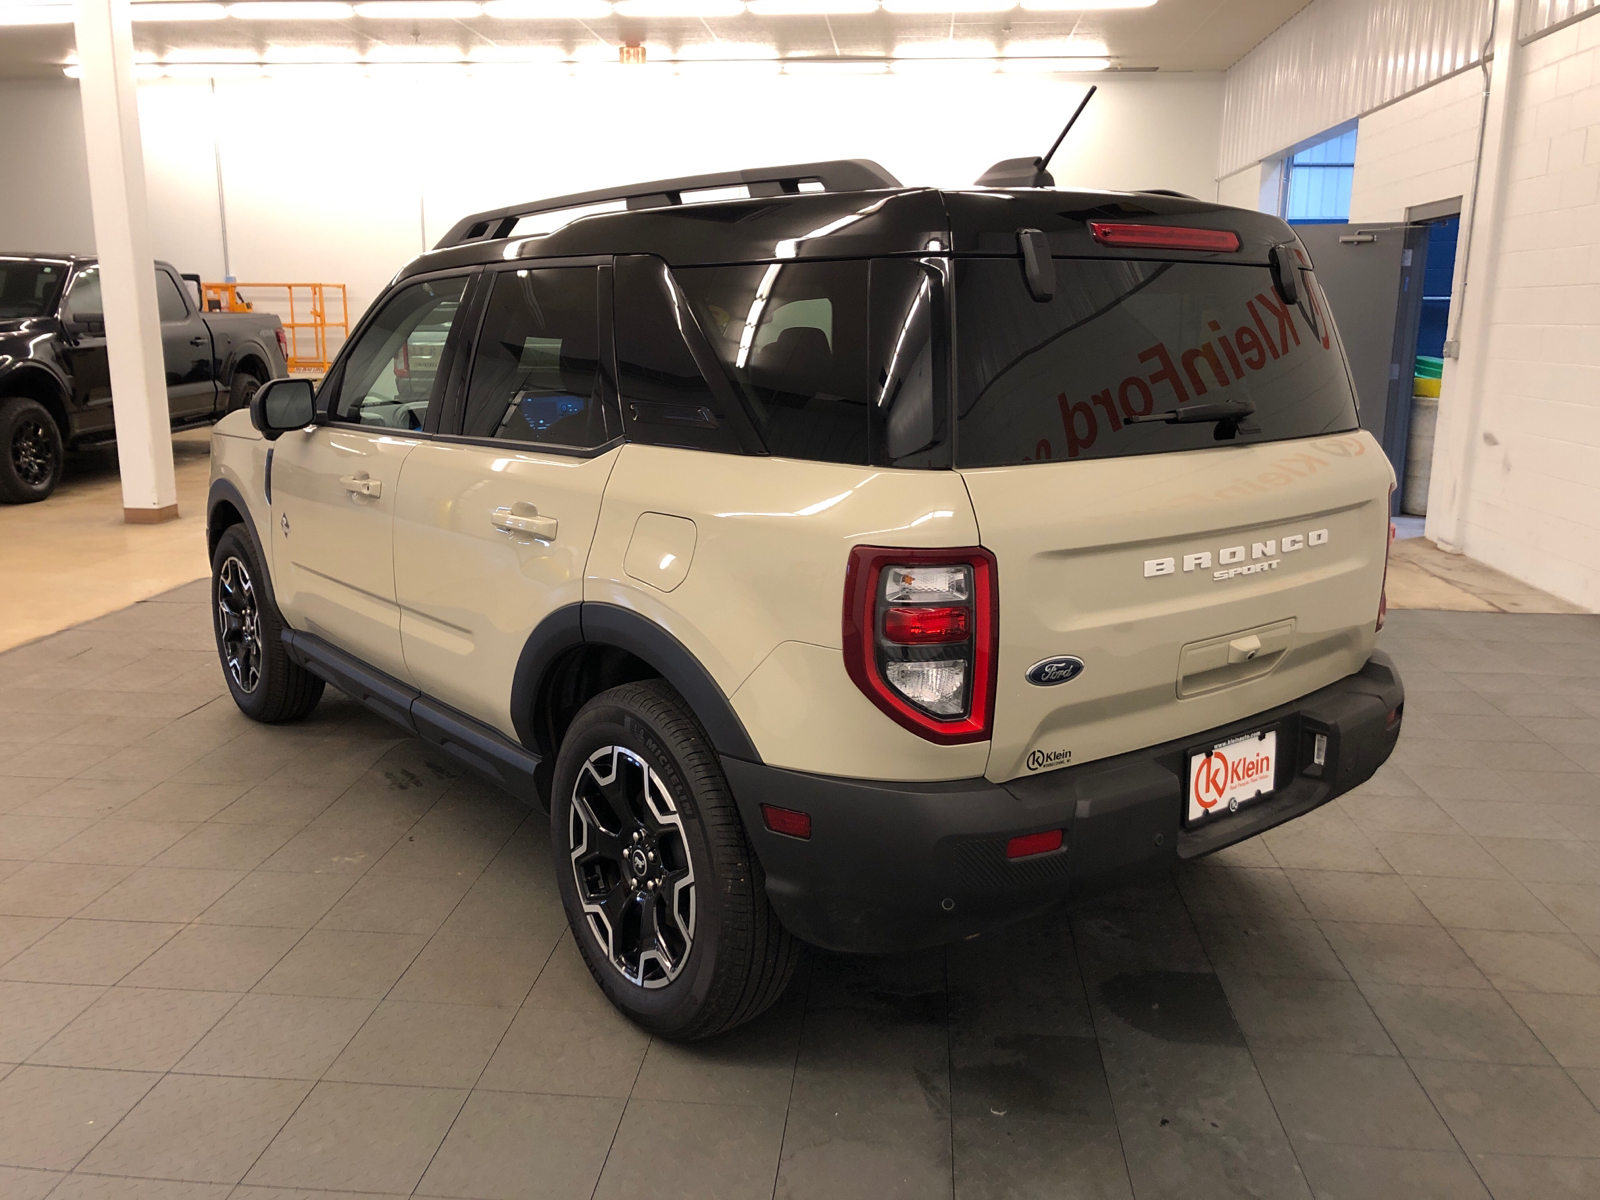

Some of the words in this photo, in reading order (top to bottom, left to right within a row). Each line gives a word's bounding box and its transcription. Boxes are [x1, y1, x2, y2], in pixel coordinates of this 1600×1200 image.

[1143, 528, 1329, 577] BRONCO
[1213, 559, 1281, 581] SPORT
[1041, 662, 1074, 681] Ford
[1045, 749, 1072, 763] Klein
[1230, 752, 1270, 784] Klein
[645, 737, 693, 815] MICHELIN
